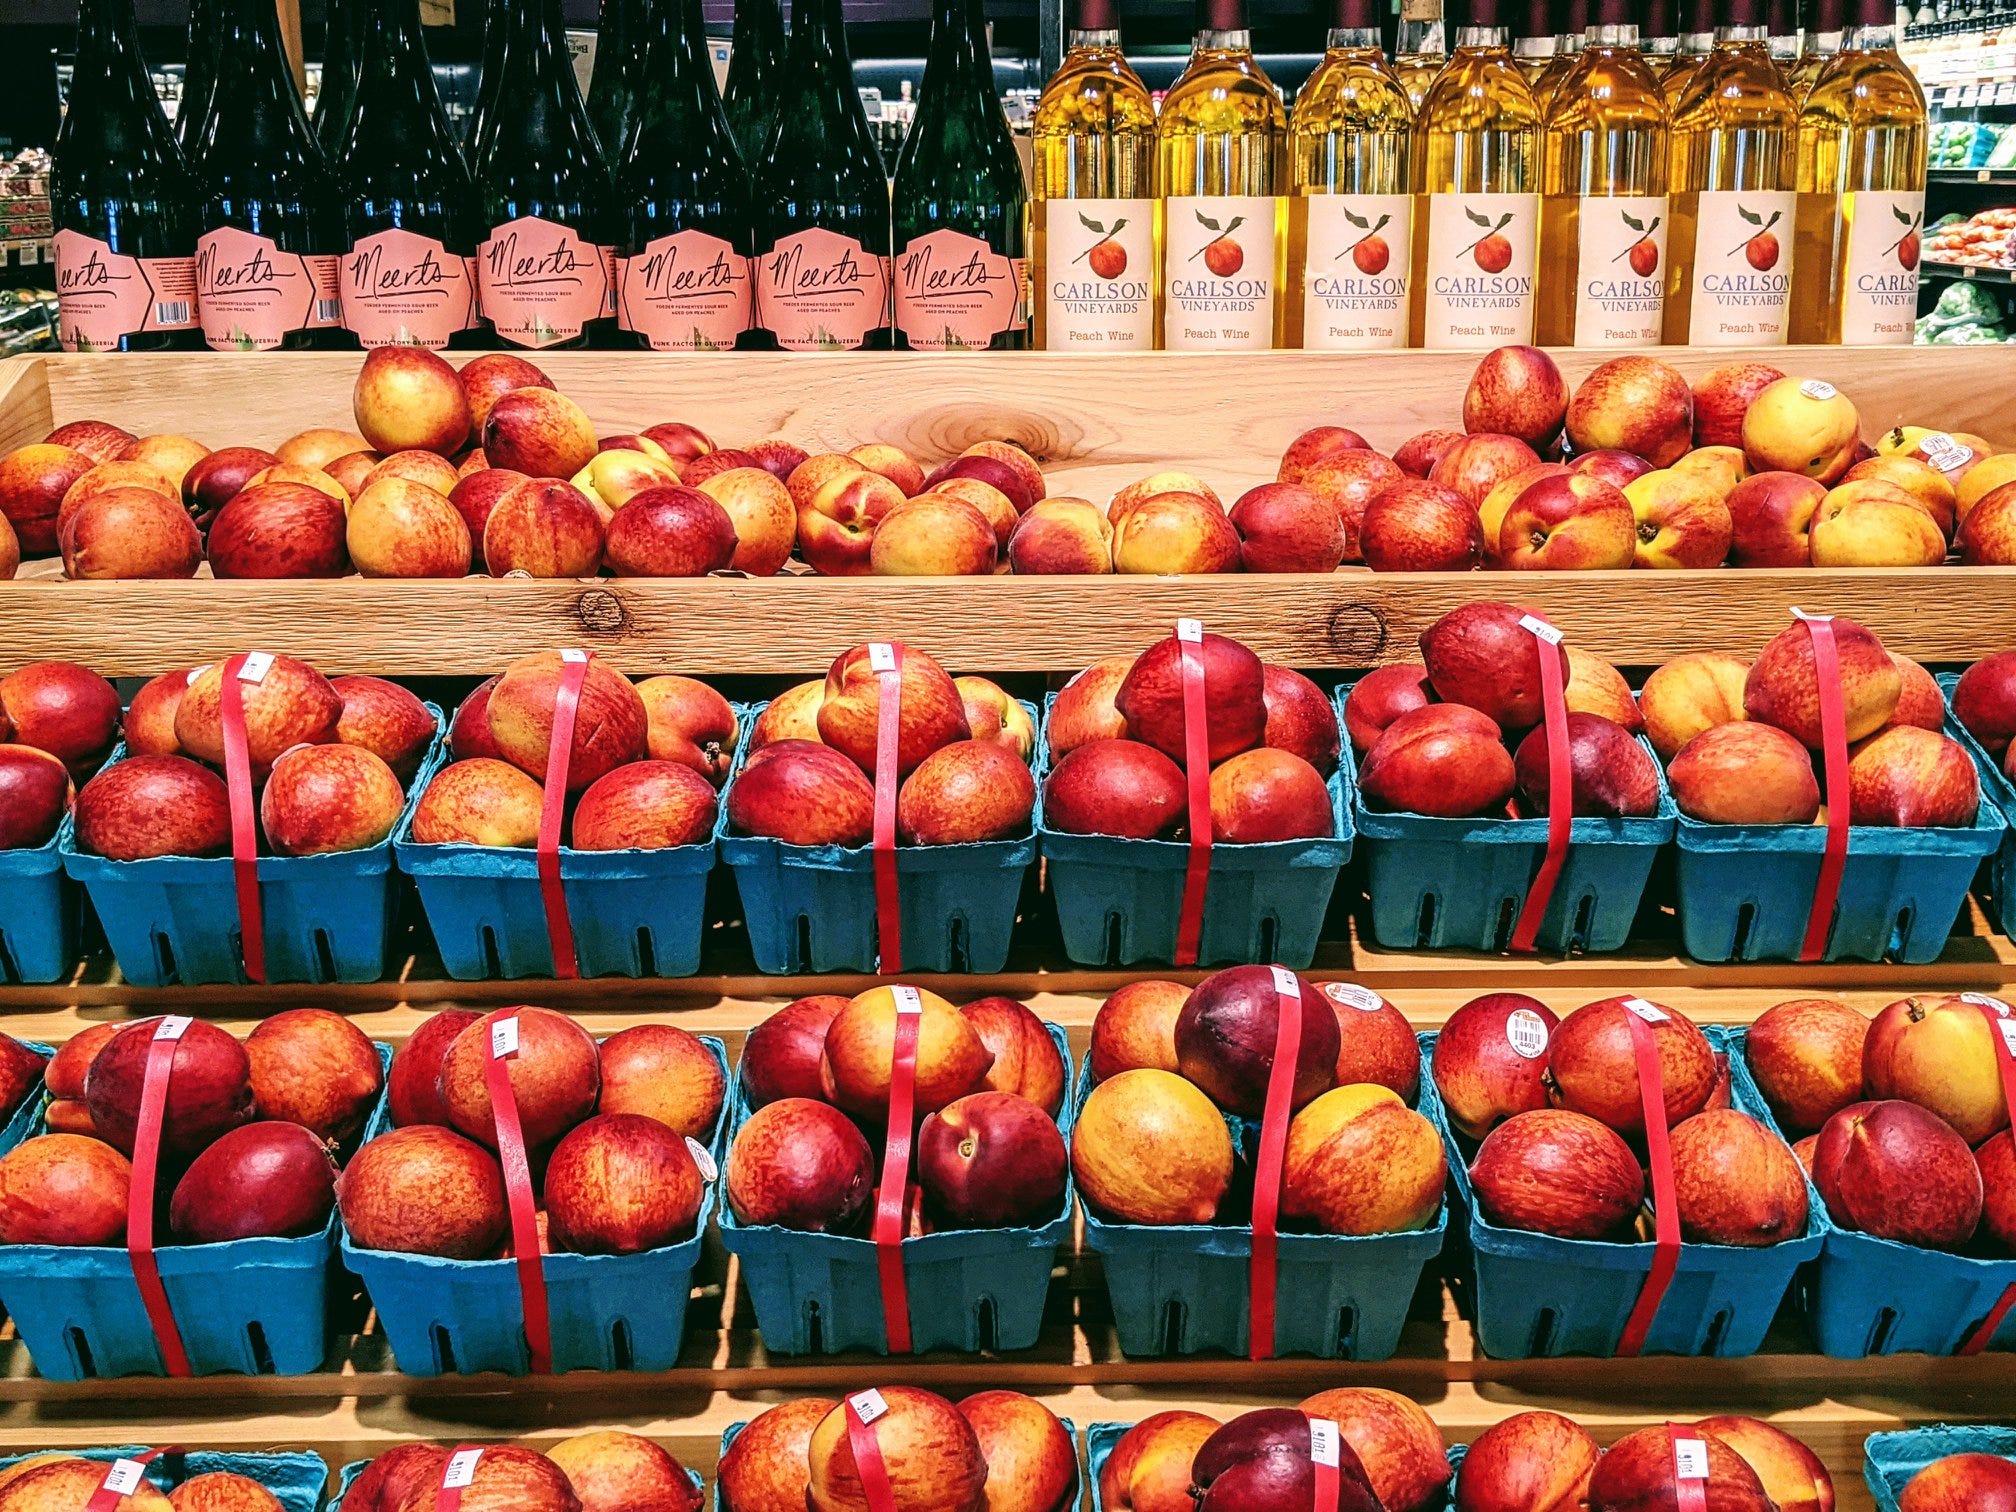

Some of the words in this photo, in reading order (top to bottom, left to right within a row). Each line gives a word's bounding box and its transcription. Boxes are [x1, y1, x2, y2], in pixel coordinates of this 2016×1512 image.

[486, 232, 594, 288] Meerts
[197, 242, 296, 298] Meerts
[349, 244, 460, 300] Meerts
[639, 245, 746, 302] Meerts
[768, 243, 876, 299] Meerts
[902, 244, 1005, 300] Meerts
[1053, 282, 1148, 299] CARLSON
[1171, 280, 1267, 297] CARLSON
[1313, 278, 1406, 295] CARLSON
[1435, 276, 1531, 293] CARLSON
[1181, 300, 1255, 311] VINEYARDS
[1326, 299, 1398, 310] VINEYARDS
[1446, 297, 1521, 308] VINEYARDS
[1716, 294, 1784, 306] VINEYARDS
[1065, 302, 1138, 314] VINEYARDS
[1184, 328, 1217, 338] Peach
[1222, 329, 1250, 339] Wine
[1329, 326, 1364, 337] Peach
[1369, 327, 1393, 337] Wine
[1449, 325, 1485, 336] Peach
[1489, 325, 1516, 336] Wine
[1719, 323, 1754, 333] Peach
[1758, 323, 1780, 333] Wine
[1873, 322, 1903, 333] Peach
[1069, 330, 1103, 341] Peach
[1108, 331, 1134, 341] Wine
[1604, 329, 1638, 339] Peach
